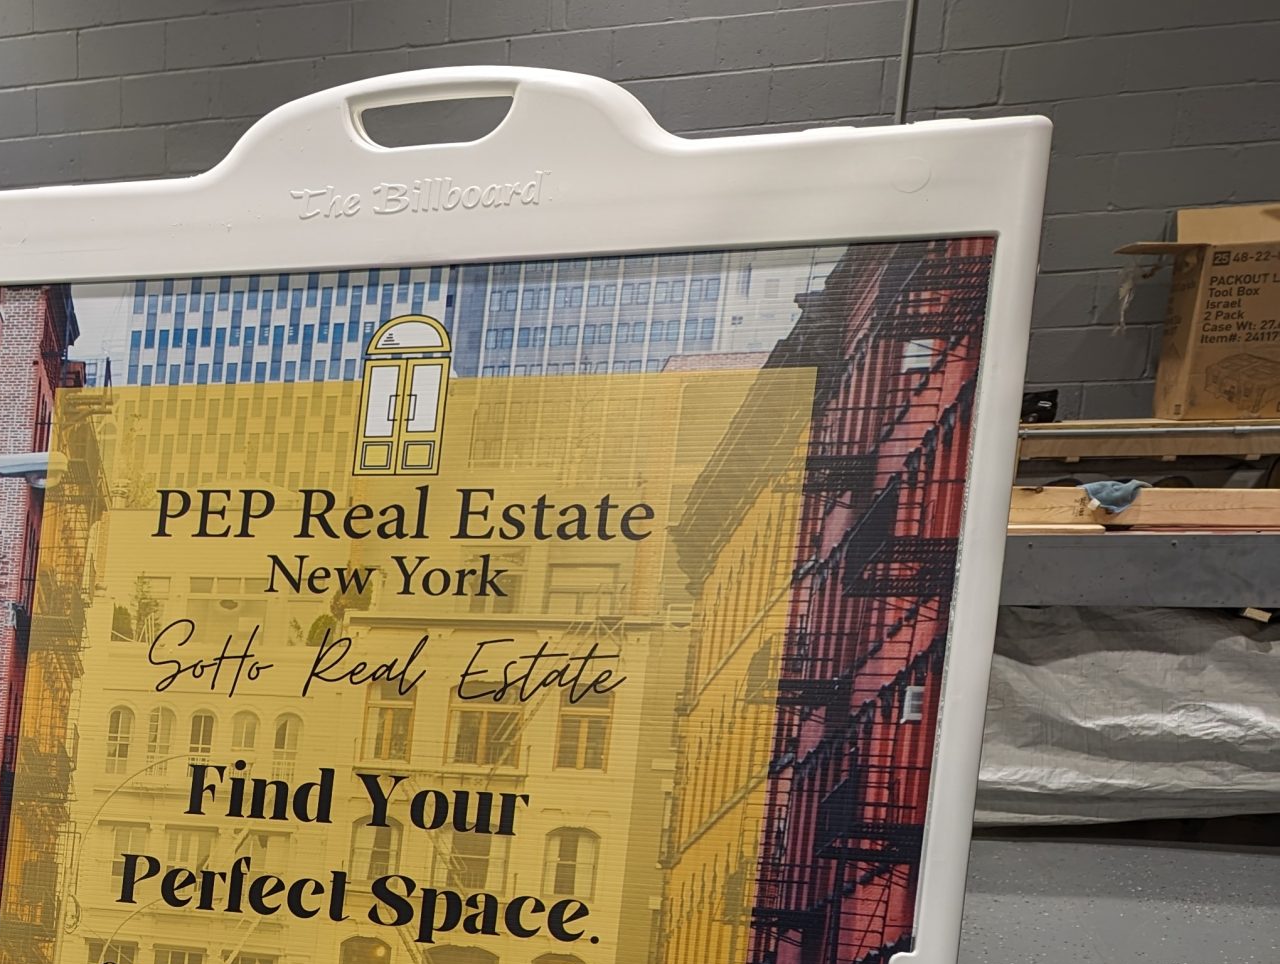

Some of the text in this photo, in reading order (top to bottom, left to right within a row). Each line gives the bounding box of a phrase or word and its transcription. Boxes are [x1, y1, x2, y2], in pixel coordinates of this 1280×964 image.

[290, 170, 544, 220] The Billboard
[1208, 286, 1260, 298] Tool Box
[1209, 273, 1270, 286] PACKOUT
[1204, 310, 1245, 320] 2 Pack
[1206, 299, 1241, 309] Israel
[1202, 322, 1232, 332] Case
[151, 485, 655, 542] PEP Real Estate
[264, 554, 508, 597] New York
[147, 619, 627, 704] SoHo Real Estate
[184, 760, 530, 836] Find Your
[115, 854, 599, 944] Perfect Space.
